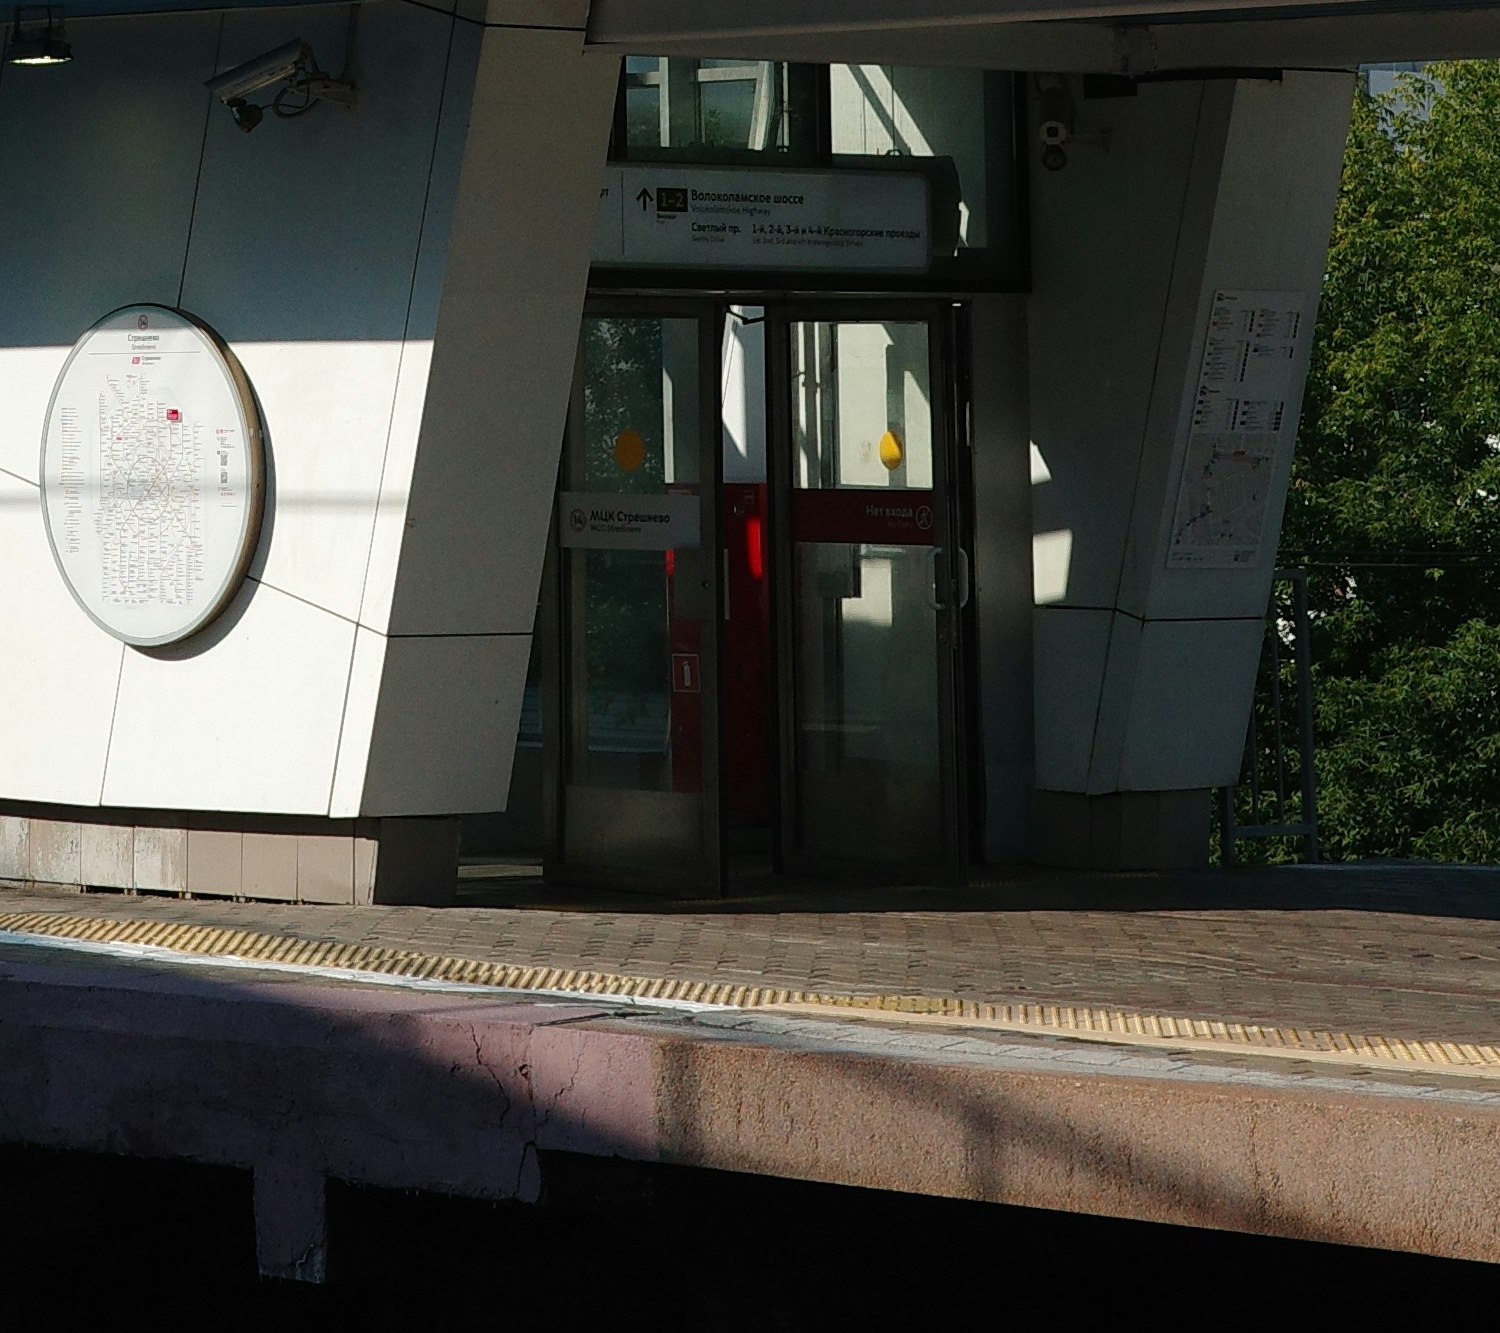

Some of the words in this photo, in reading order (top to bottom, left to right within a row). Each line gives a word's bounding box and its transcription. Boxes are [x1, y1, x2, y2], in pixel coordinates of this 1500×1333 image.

[691, 189, 771, 204] Волоколамское
[773, 195, 804, 205] шоссе
[691, 222, 727, 233] Светлый
[728, 225, 741, 235] пр.
[590, 510, 615, 523] МЦК
[617, 511, 671, 525] Стрешнево
[866, 504, 883, 517] Нет
[885, 507, 913, 519] входа
